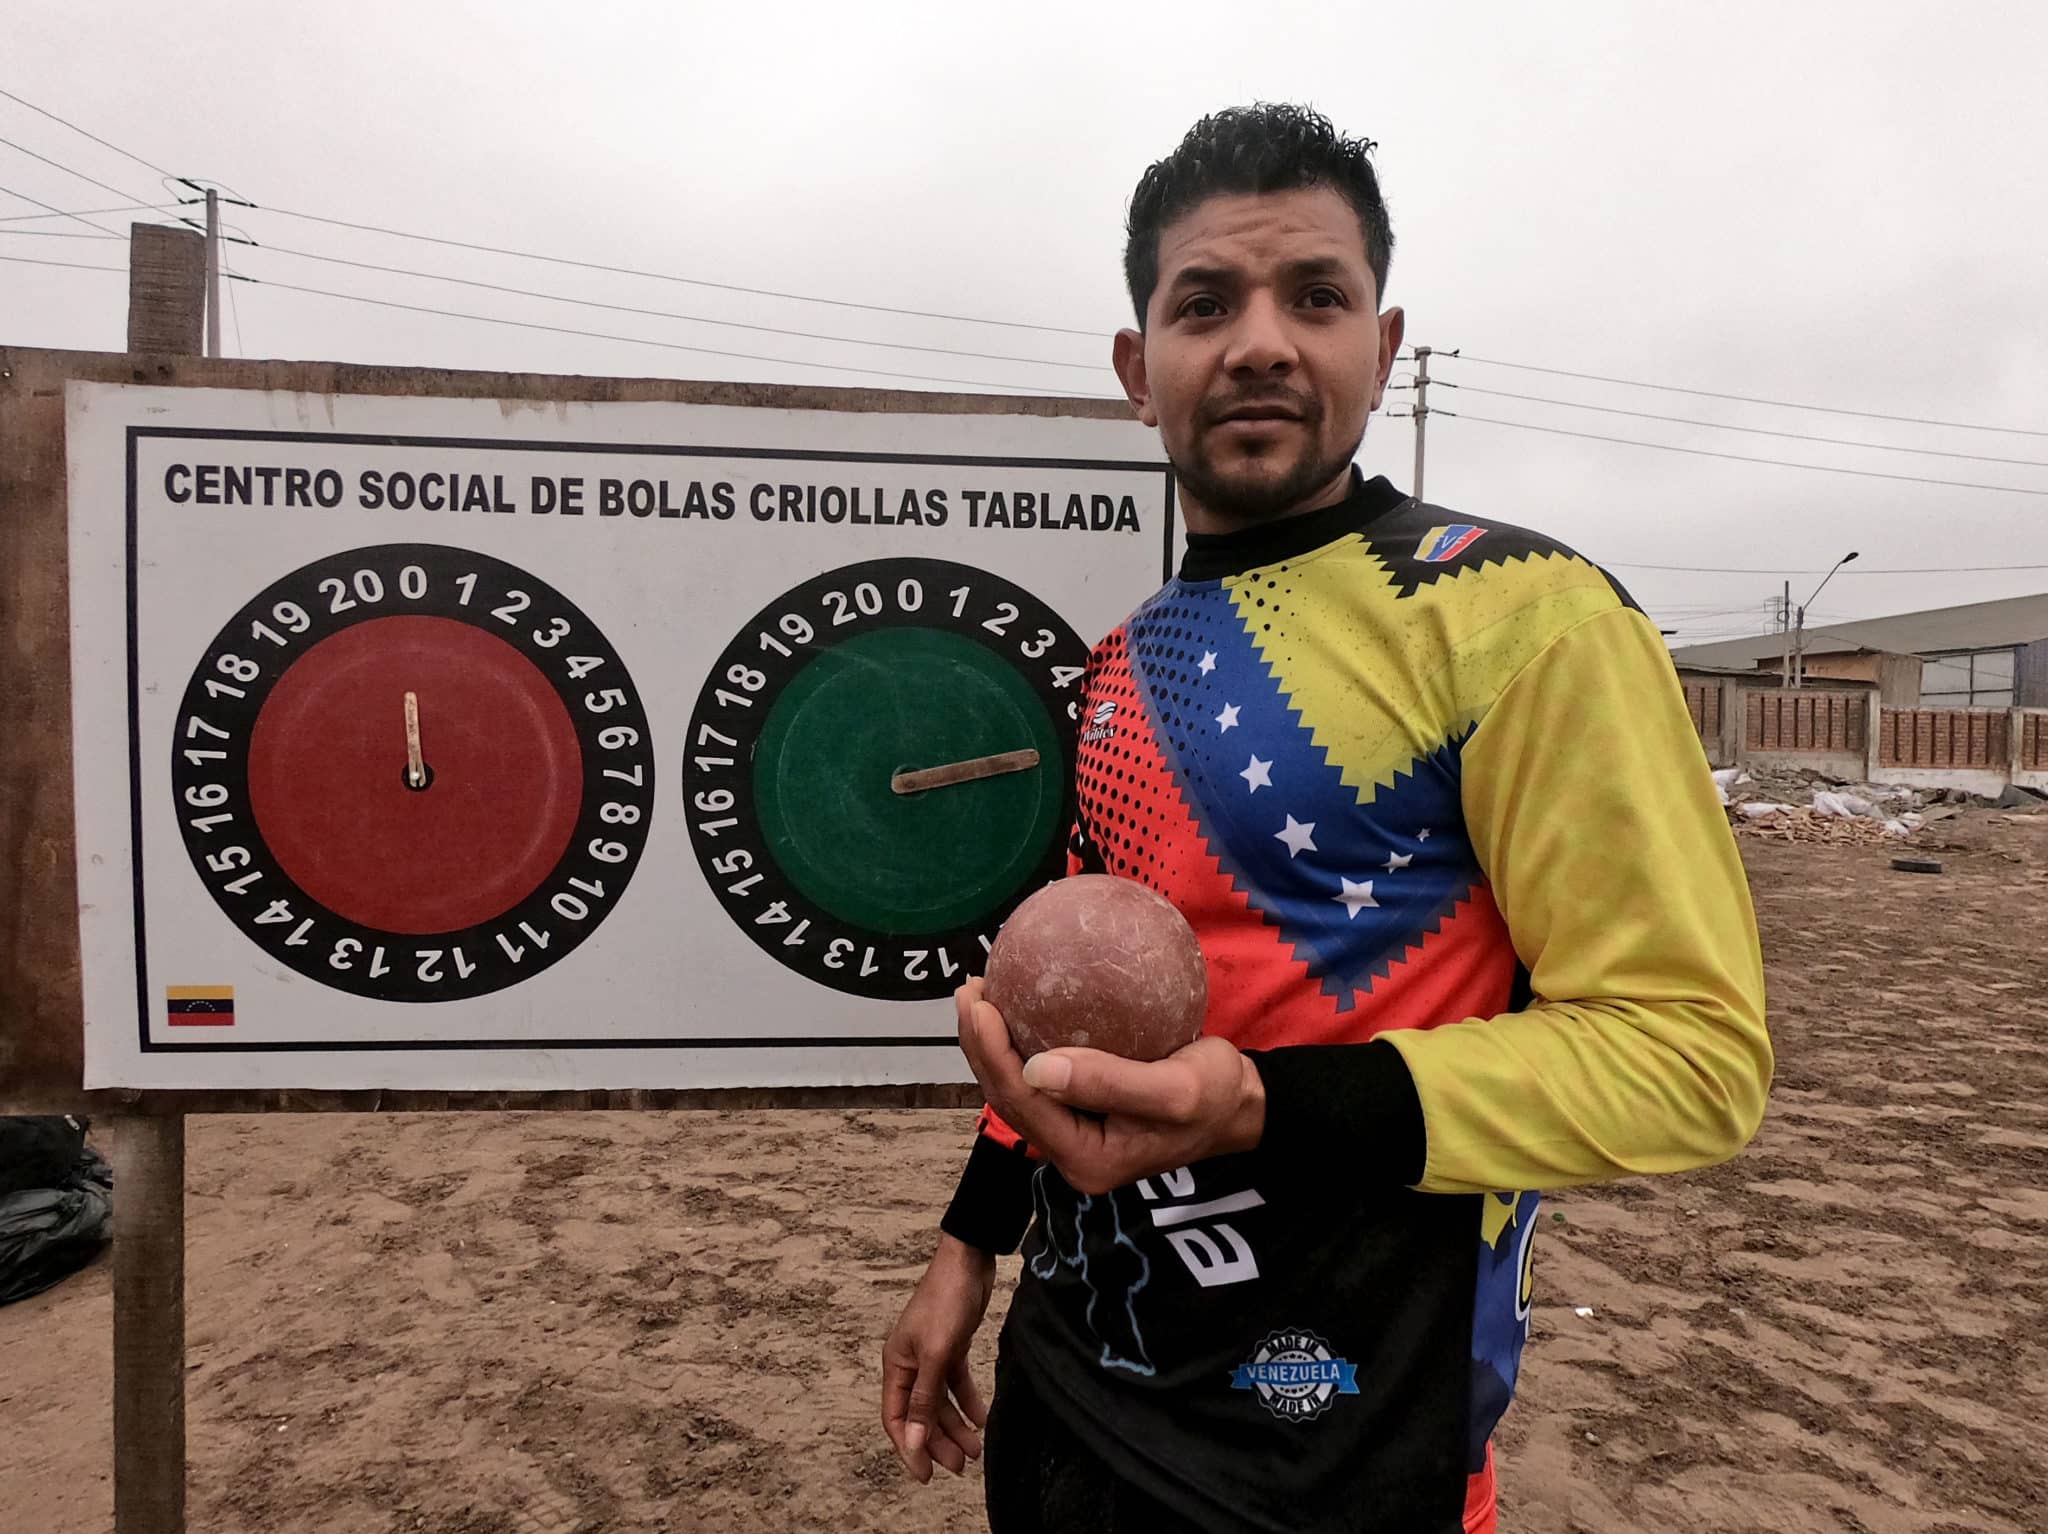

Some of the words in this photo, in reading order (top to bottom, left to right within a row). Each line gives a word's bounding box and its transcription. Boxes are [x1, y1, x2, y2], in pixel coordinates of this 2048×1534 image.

[164, 463, 344, 509] CENTRO
[358, 470, 516, 514] SOCIAL
[531, 476, 584, 516] DE
[599, 478, 736, 521] BOLAS
[749, 483, 949, 527] CRIOLLAS
[961, 490, 1141, 533] TABLADA
[318, 569, 384, 614] 20
[399, 565, 428, 600] 0
[455, 572, 478, 606] 1
[897, 578, 923, 612] 0
[490, 590, 531, 625] 2
[822, 582, 883, 626] 20
[949, 586, 970, 618] 1
[981, 602, 1019, 637] 2
[251, 601, 311, 647] 19
[532, 617, 571, 648] 3
[759, 613, 814, 657] 19
[1020, 628, 1056, 658] 3
[204, 653, 260, 699] 18
[565, 655, 605, 679] 4
[714, 663, 767, 708] 18
[1050, 665, 1086, 688] 4
[584, 688, 627, 713] 5
[183, 715, 230, 766] 17
[598, 726, 639, 750] 6
[694, 723, 738, 772] 17
[602, 764, 643, 787] 7
[185, 783, 233, 833] 16
[599, 802, 641, 825] 8
[694, 789, 738, 837] 16
[588, 838, 628, 863] 9
[205, 846, 263, 895] 15
[711, 849, 764, 897] 15
[550, 877, 605, 921] 10
[253, 899, 315, 946] 14
[754, 900, 811, 946] 14
[329, 937, 391, 978] 13
[495, 921, 550, 963] 11
[823, 938, 879, 977] 13
[415, 946, 476, 983] 12
[903, 947, 959, 981] 12
[1265, 1335, 1303, 1356] MADE
[1303, 1338, 1321, 1354] IN
[1246, 1363, 1341, 1382] VENEZUELA
[1268, 1394, 1305, 1413] MADE
[1306, 1392, 1322, 1409] IN
